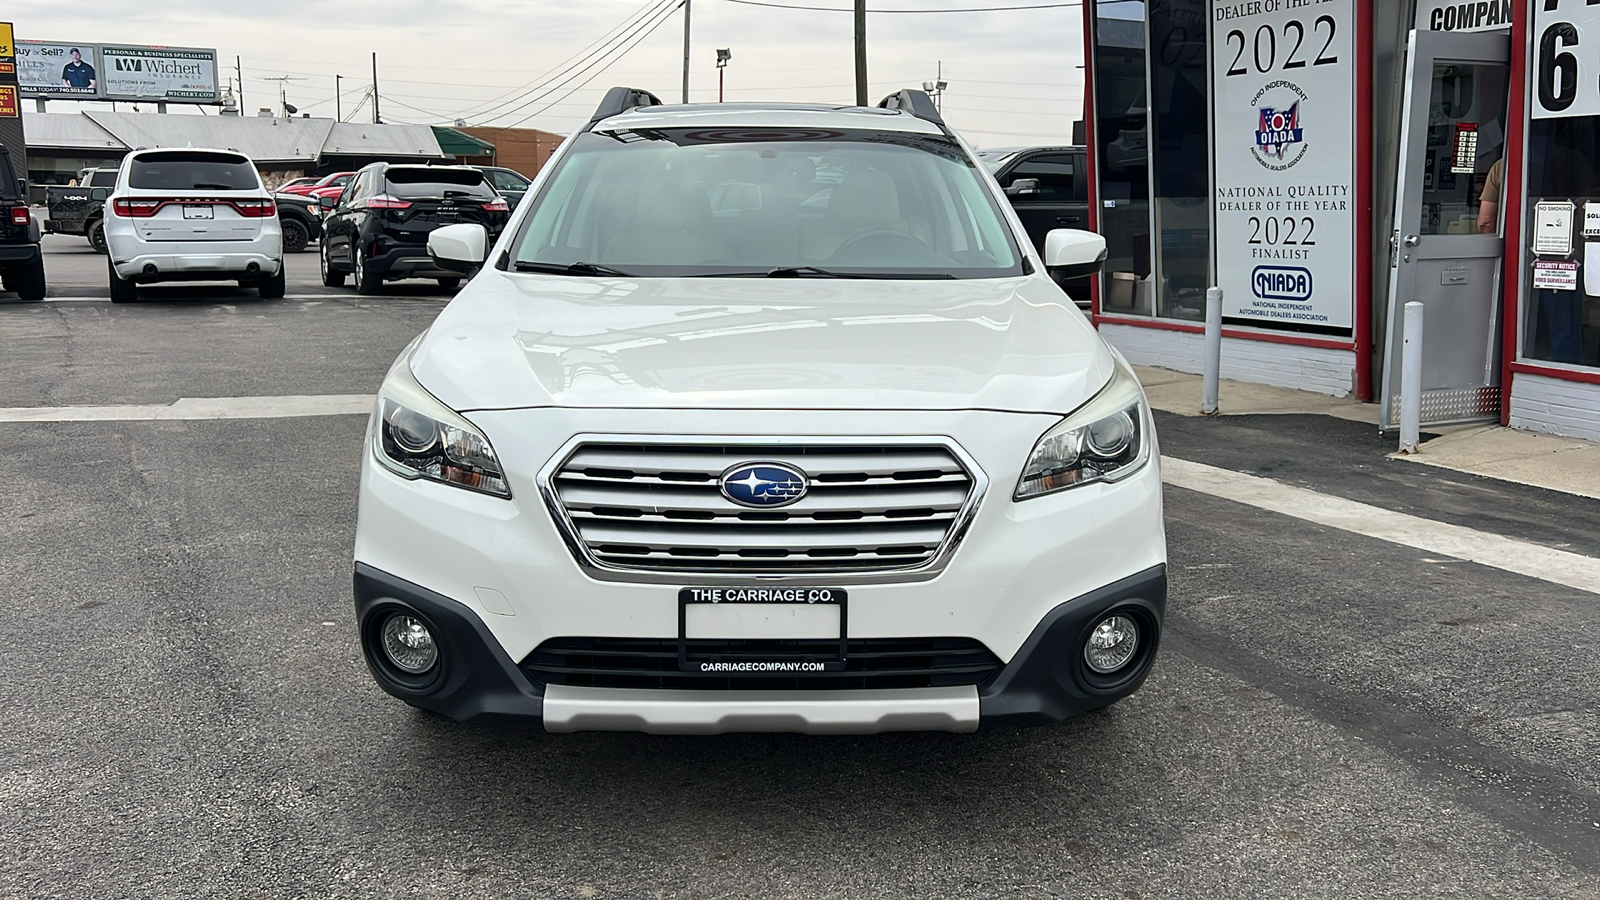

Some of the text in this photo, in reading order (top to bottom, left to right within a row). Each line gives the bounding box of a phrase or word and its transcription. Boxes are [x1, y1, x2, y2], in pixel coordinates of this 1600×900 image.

[1216, 1, 1262, 21] DEALER
[41, 47, 64, 56] Sell?
[1226, 14, 1338, 77] 2022
[144, 59, 202, 75] Wichert
[167, 90, 214, 98] WICHERT.COM
[1250, 80, 1309, 107] OHIO INDEPENDENT
[1260, 130, 1295, 144] OIADA
[1250, 146, 1270, 170] AUTOMOBILE
[1287, 142, 1309, 169] ASSOCIATION
[1218, 185, 1349, 199] NATIONAL QUALITY
[1219, 200, 1347, 211] DEALER OF THE YEAR
[1247, 216, 1316, 246] 2022
[1252, 248, 1310, 260] FINALIST
[1256, 273, 1307, 294] NIADA
[1252, 301, 1313, 311] NATIONAL INDEPENDENT
[1239, 308, 1328, 322] AUTOMOBILE DEALERS ASSOCIATION
[691, 589, 835, 602] THE CARRIAGE CO.
[700, 662, 825, 672] CARRIAGECOMPANY.COM
